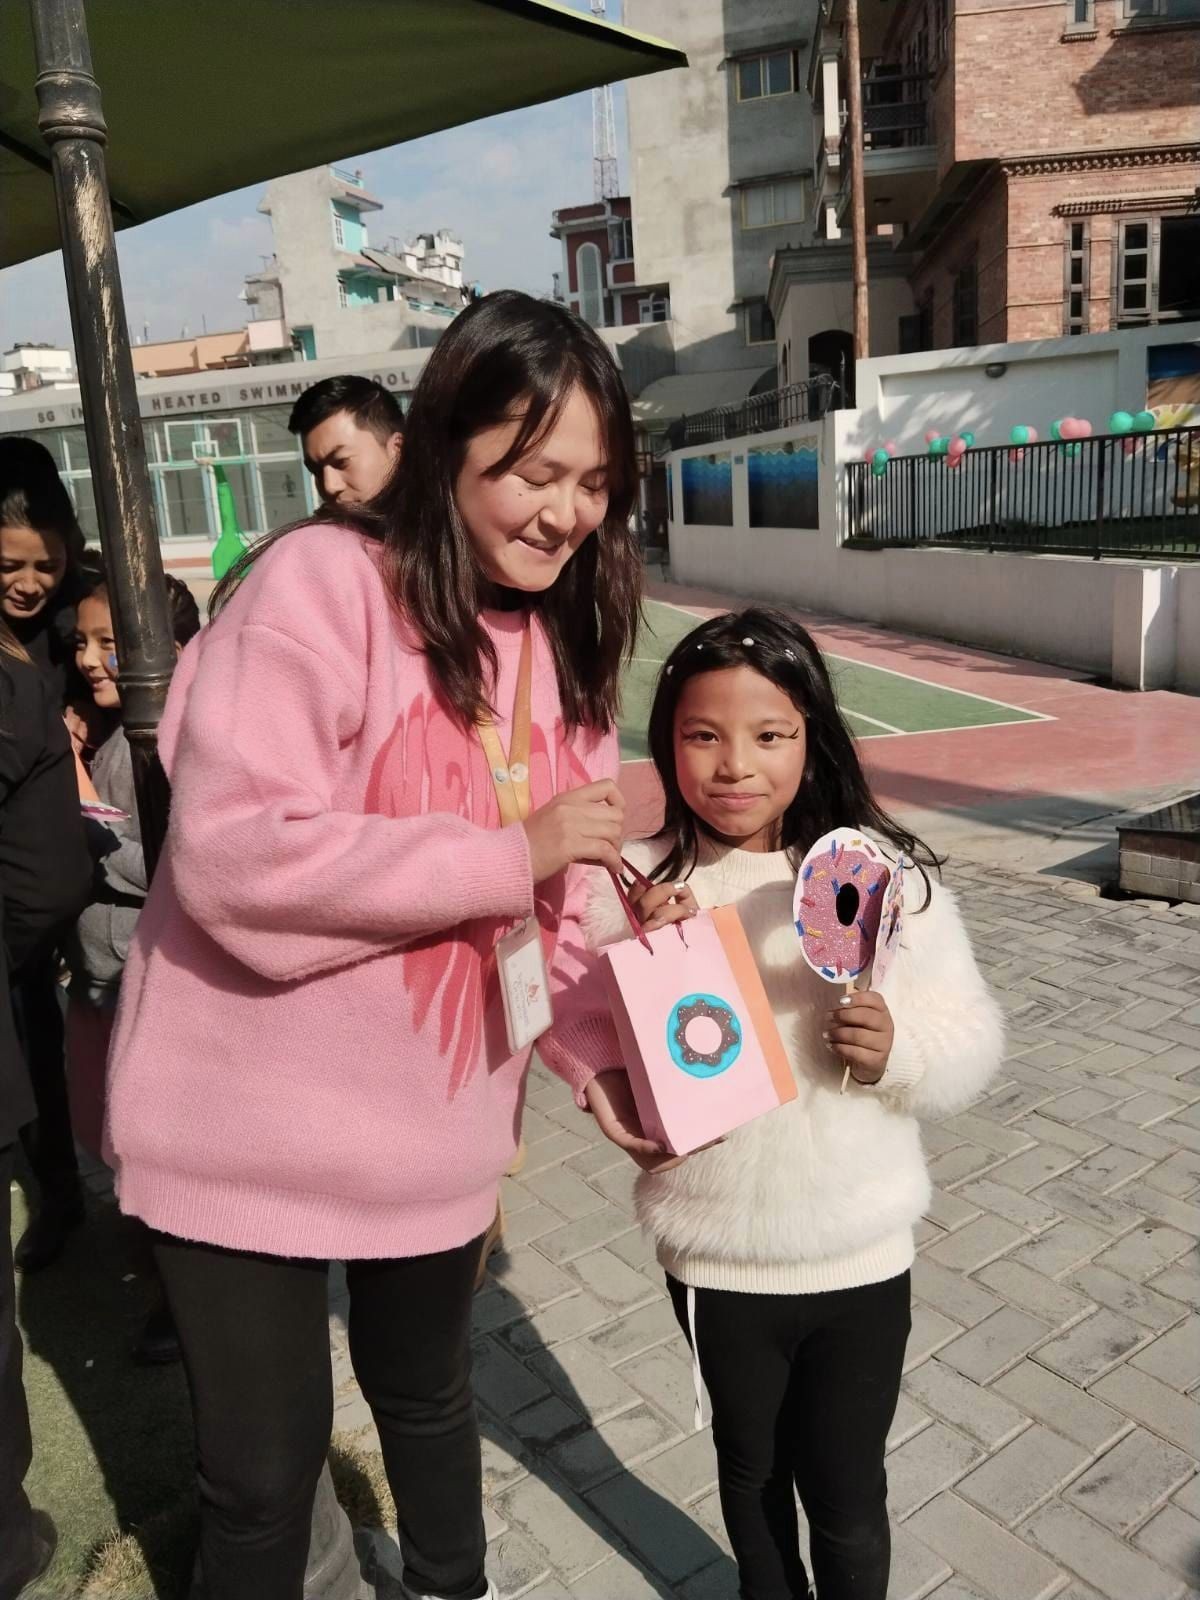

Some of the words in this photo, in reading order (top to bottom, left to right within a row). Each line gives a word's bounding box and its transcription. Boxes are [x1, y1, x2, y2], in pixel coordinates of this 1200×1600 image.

[37, 410, 56, 424] SG
[152, 392, 221, 410] HEATED
[371, 371, 410, 386] OOL
